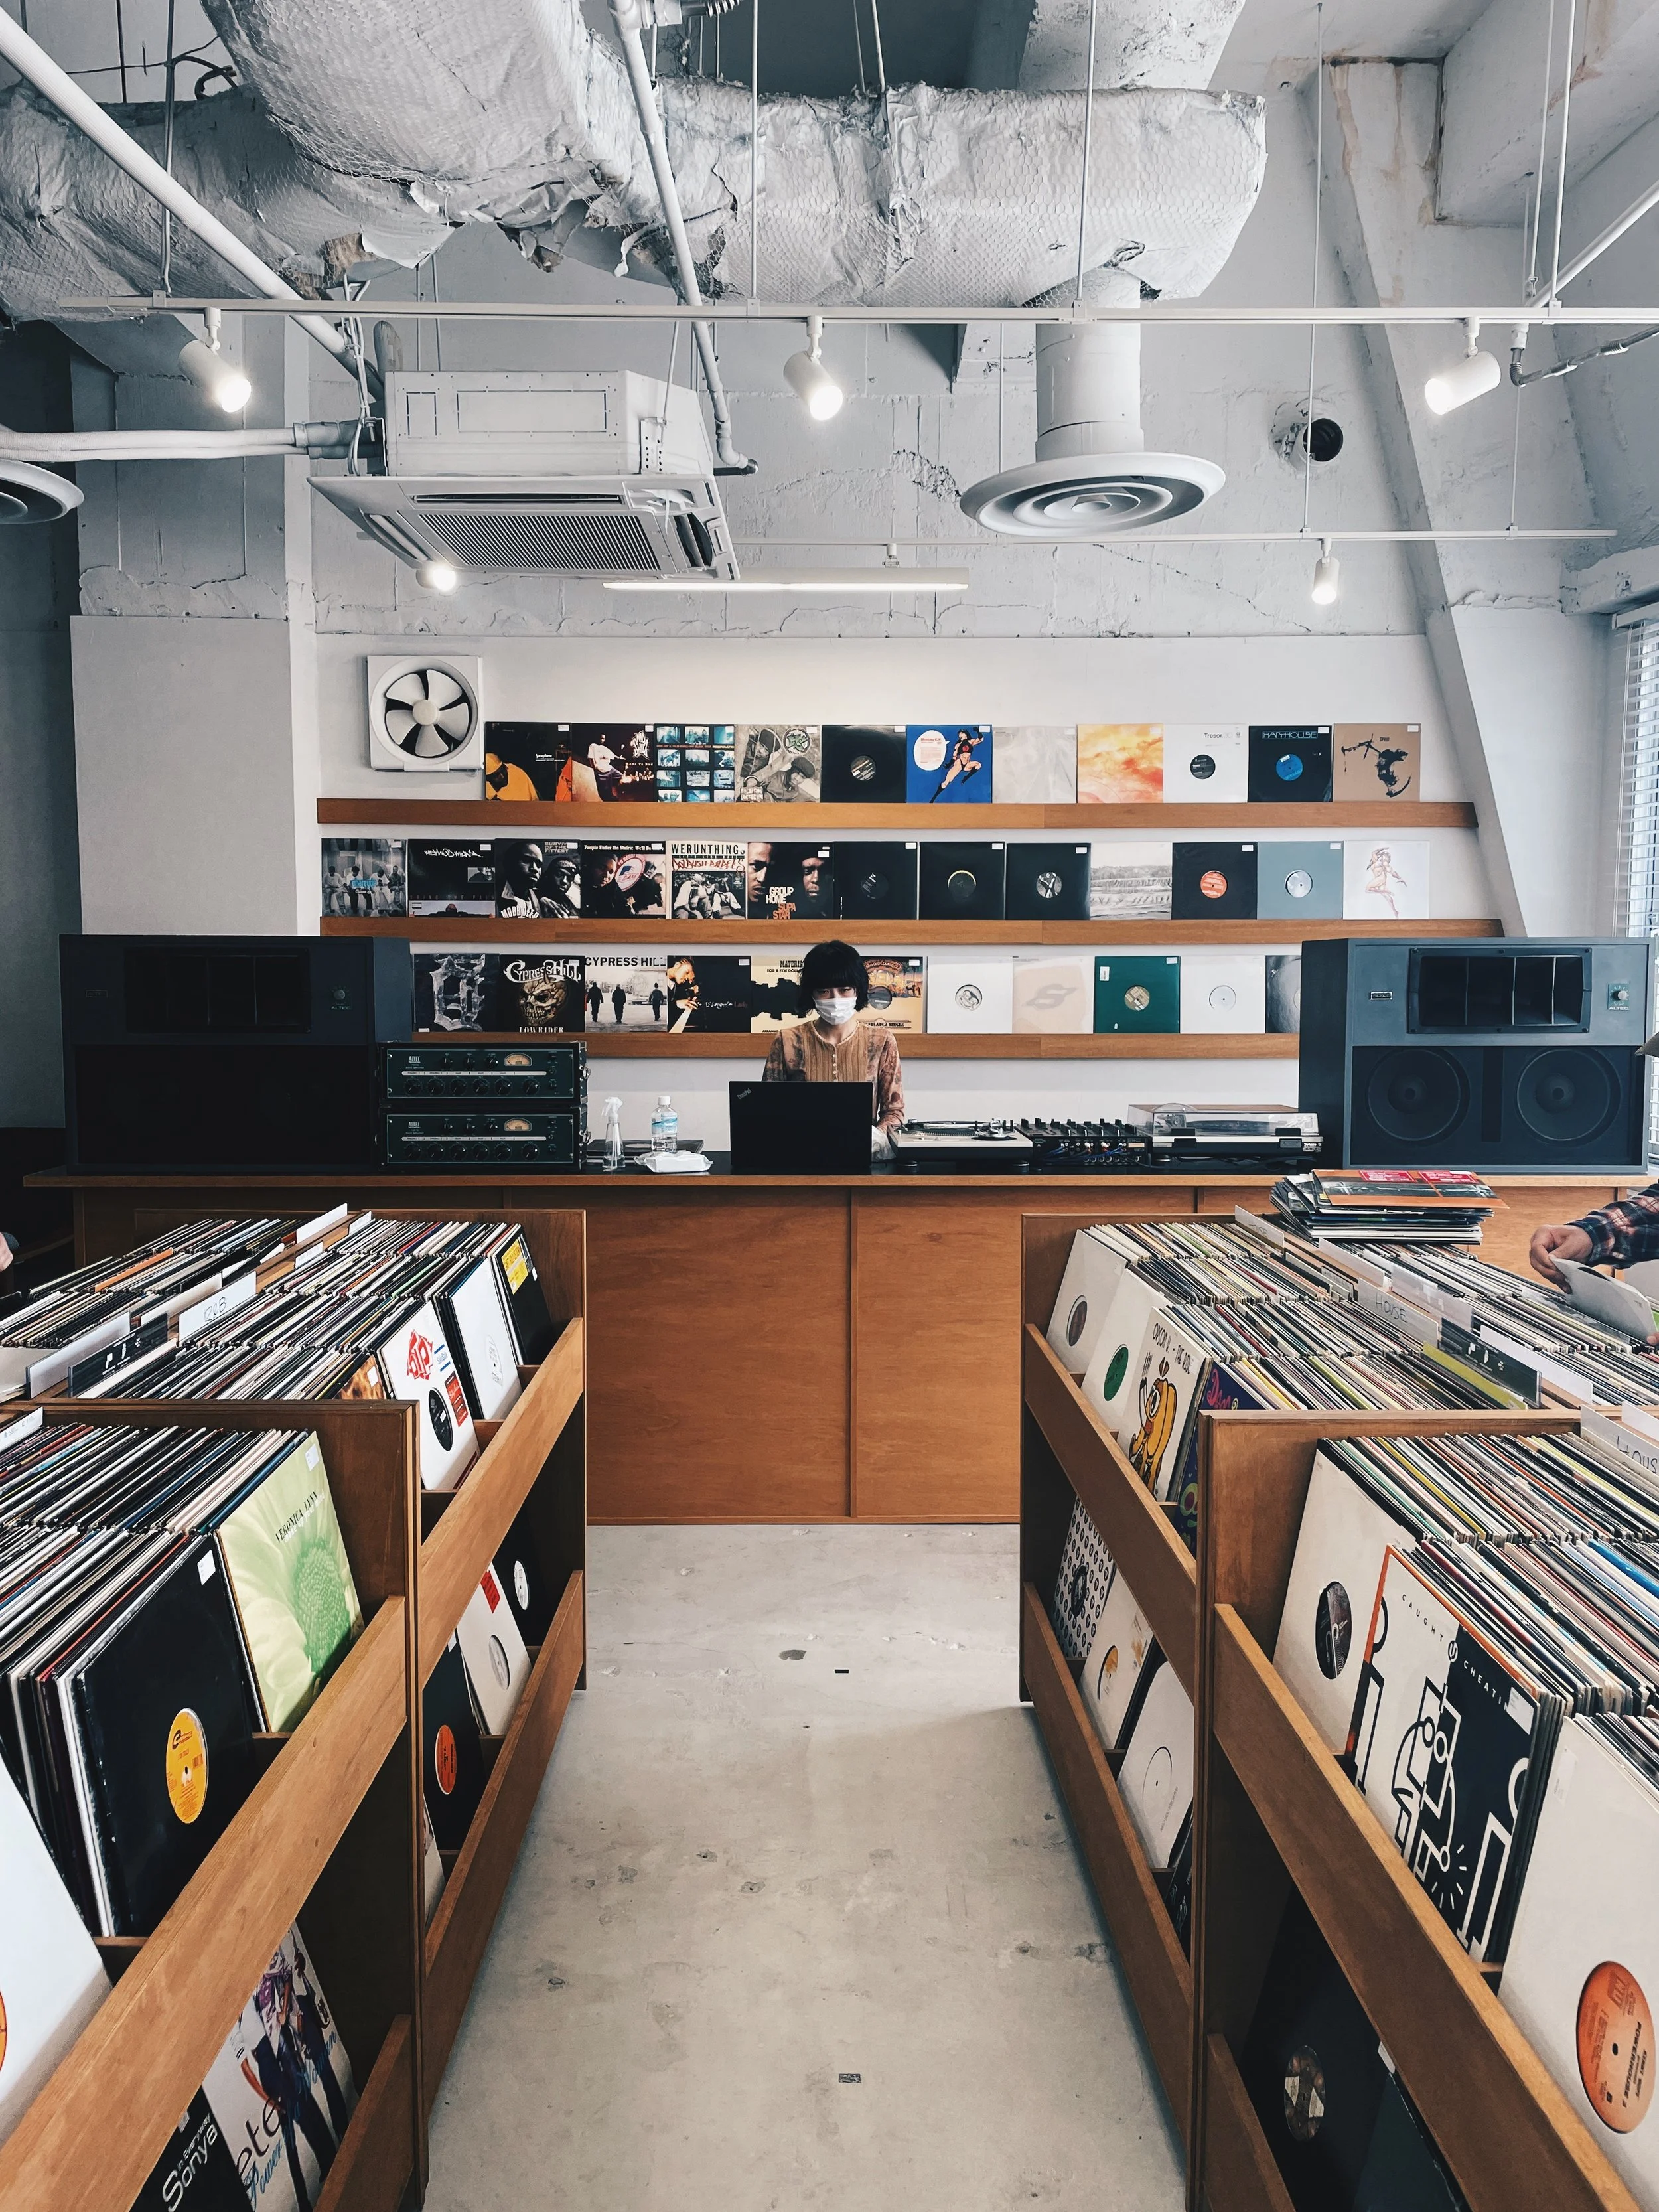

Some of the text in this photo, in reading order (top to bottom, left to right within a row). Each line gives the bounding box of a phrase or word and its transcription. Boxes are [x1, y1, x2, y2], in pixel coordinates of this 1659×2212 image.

[769, 886, 794, 896] GROUP
[766, 894, 787, 904] HOME
[778, 903, 796, 912] SUPA
[772, 910, 791, 920] STAR
[585, 956, 638, 966] CYPRESS
[779, 960, 804, 968] MATERIA
[1402, 1593, 1444, 1643] CAUGHT
[162, 2124, 219, 2212] Sonya
